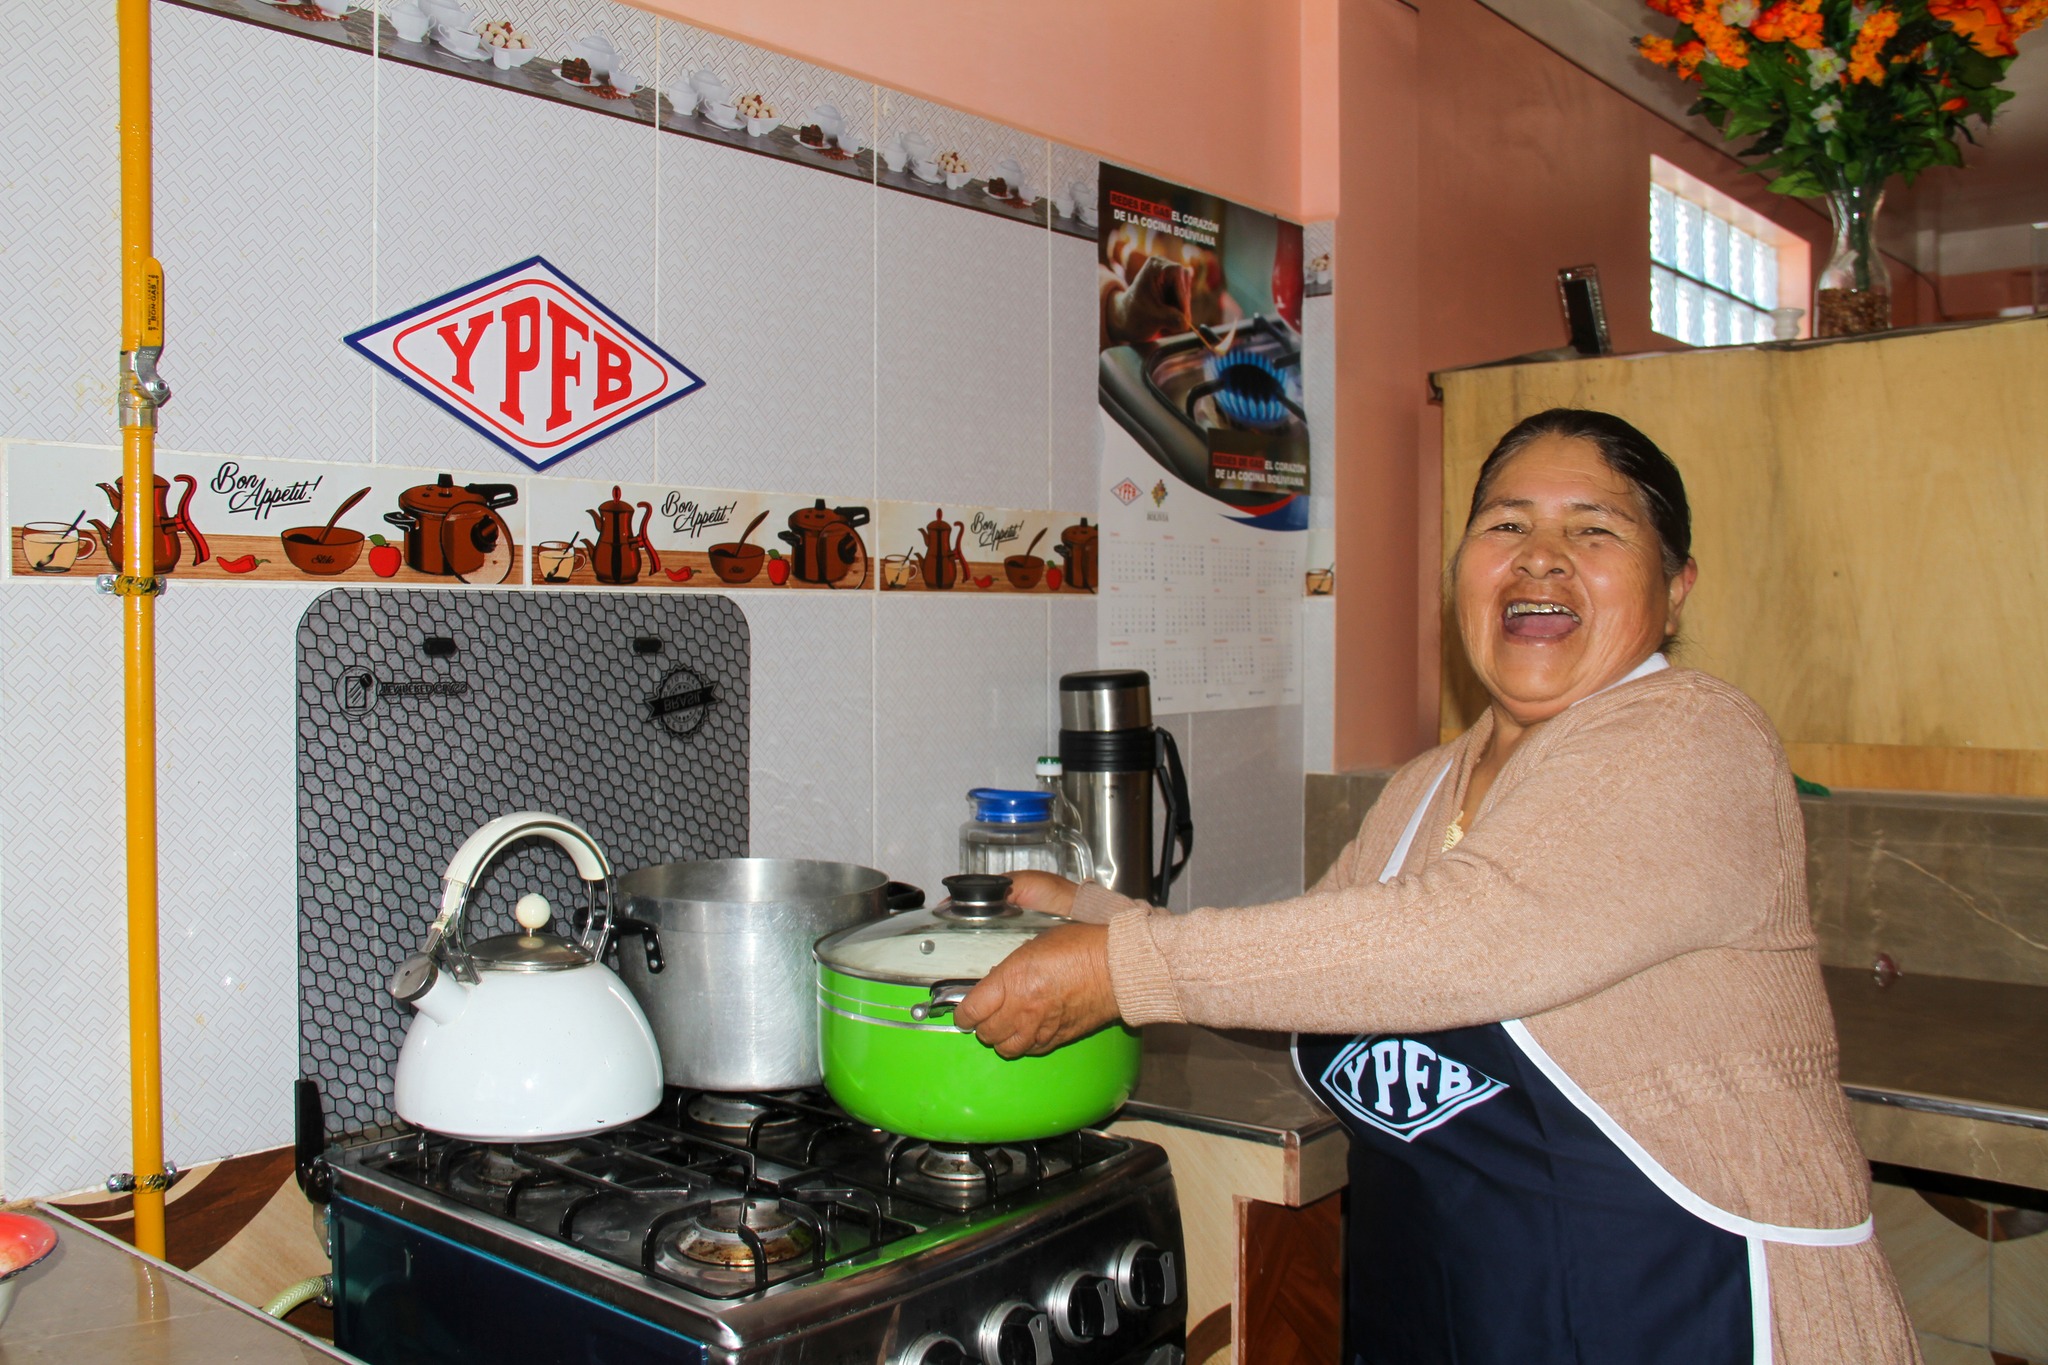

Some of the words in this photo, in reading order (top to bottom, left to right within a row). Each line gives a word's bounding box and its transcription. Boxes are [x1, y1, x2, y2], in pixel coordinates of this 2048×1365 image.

[1153, 205, 1170, 218] GAS
[1171, 210, 1182, 222] EL
[1113, 209, 1126, 221] DE
[1128, 213, 1139, 225] LA
[1140, 217, 1172, 234] COCINA
[1173, 226, 1216, 247] BOLIVIANA
[436, 296, 633, 432] YPFB
[211, 461, 259, 494] Bon
[1215, 469, 1226, 479] DE
[1227, 470, 1236, 480] LA
[1237, 471, 1265, 482] COCINA
[1267, 474, 1304, 486] BOLIVIANA
[1264, 460, 1273, 470] EL
[661, 490, 694, 518] Bon
[970, 511, 994, 535] Bon
[1343, 1038, 1473, 1118] YPFB
